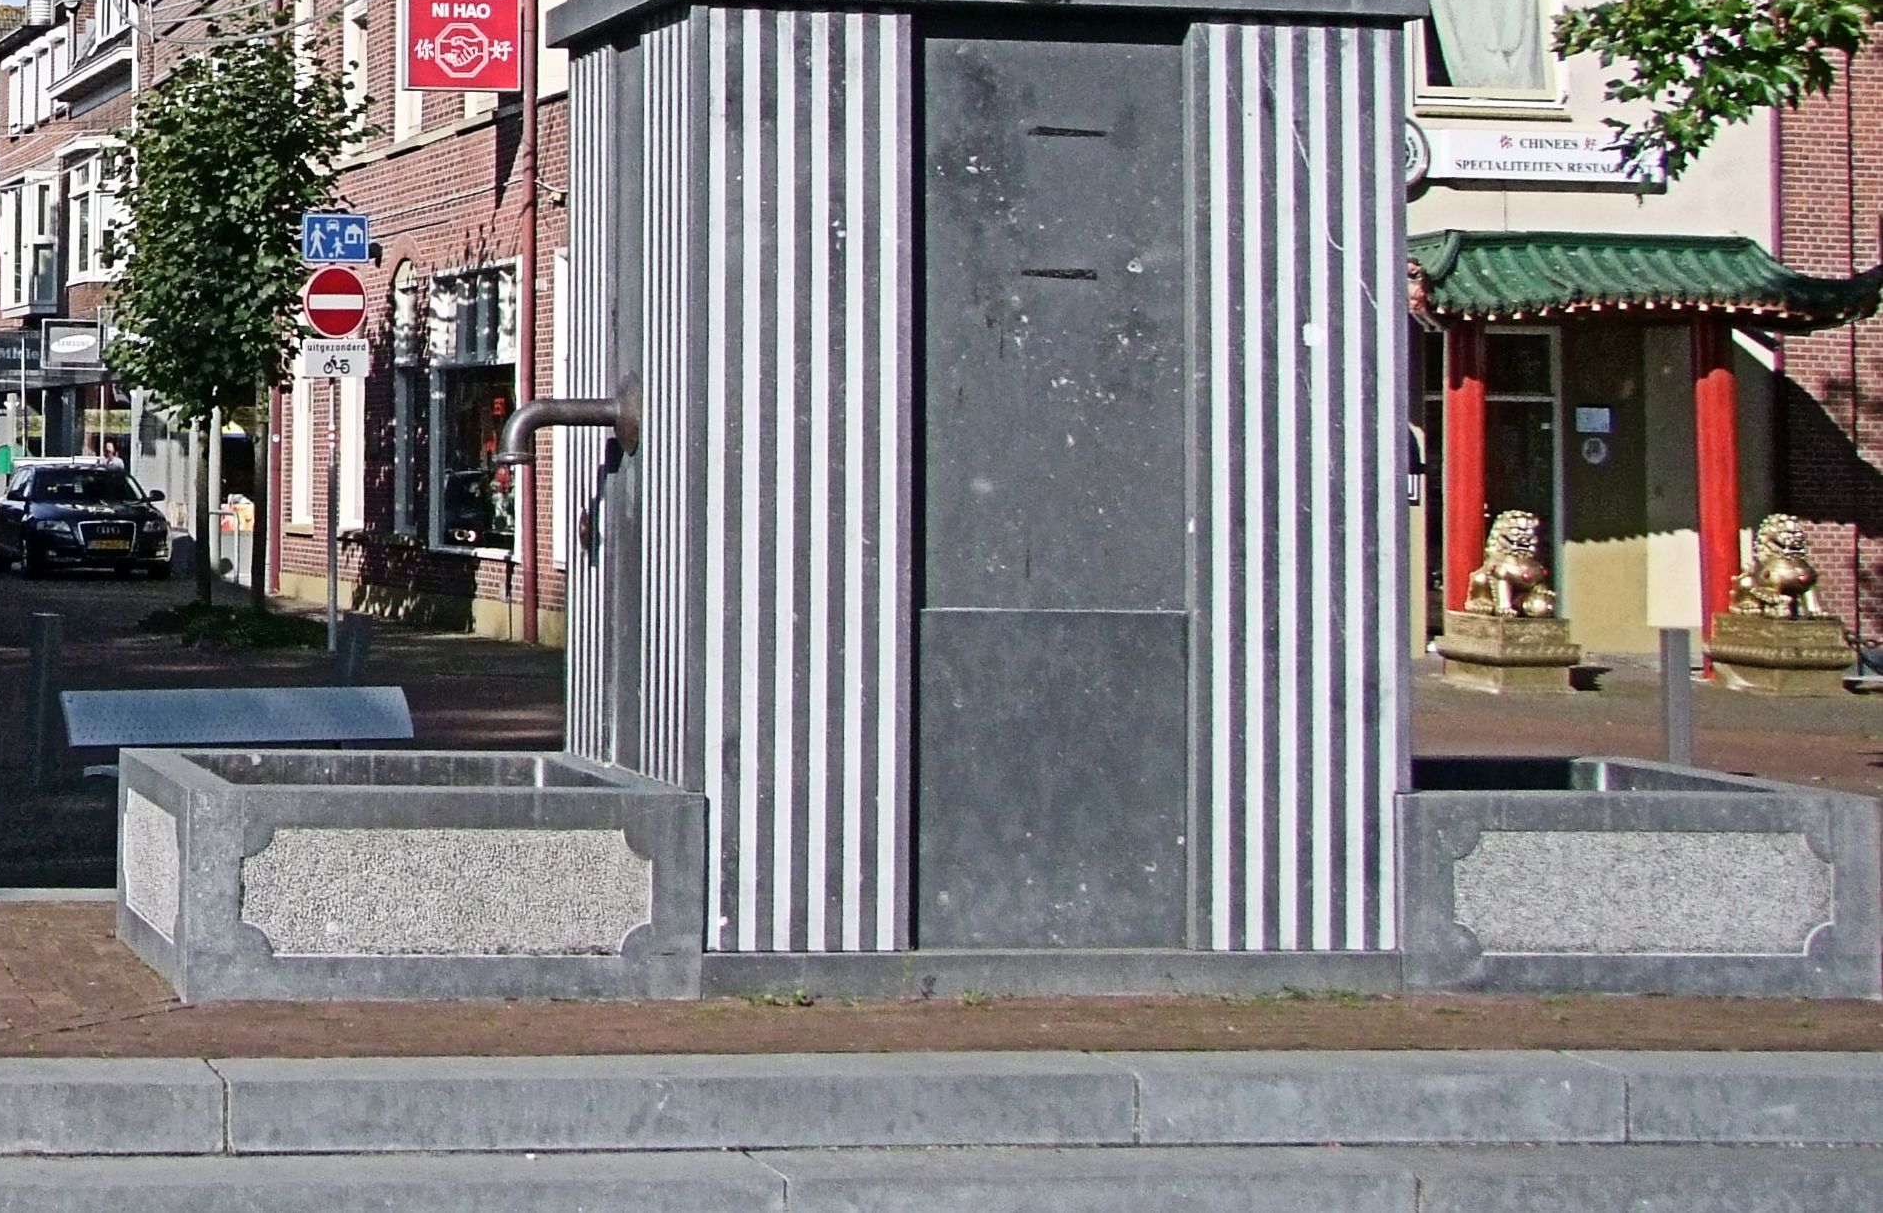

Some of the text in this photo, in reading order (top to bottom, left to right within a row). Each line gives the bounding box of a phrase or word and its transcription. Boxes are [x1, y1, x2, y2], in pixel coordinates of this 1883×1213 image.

[431, 2, 491, 19] NI HAO
[414, 38, 513, 62] 你 好
[1519, 138, 1579, 150] CHINEES
[1454, 159, 1564, 173] SPECIALITEITEN
[307, 343, 366, 354] uitgezonderd
